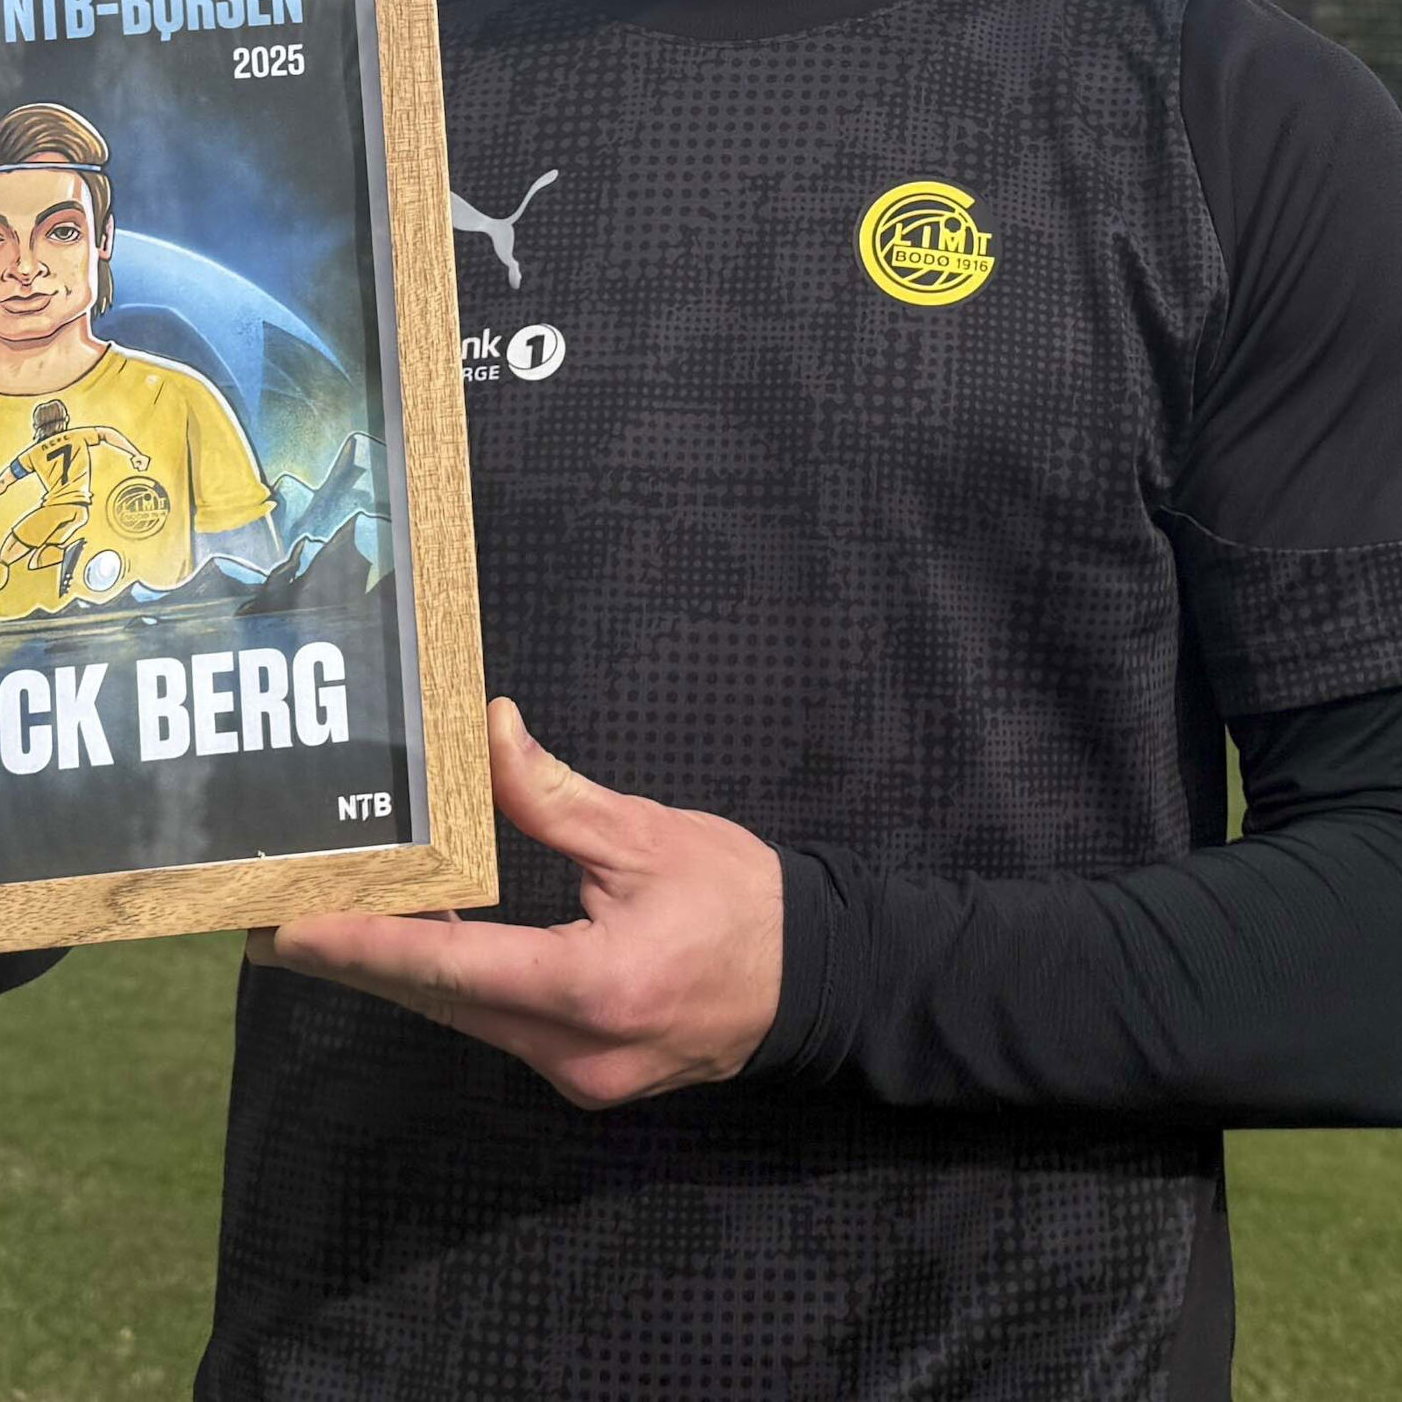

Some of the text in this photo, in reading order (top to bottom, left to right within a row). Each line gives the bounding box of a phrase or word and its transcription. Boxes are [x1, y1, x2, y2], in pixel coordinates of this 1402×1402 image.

[232, 43, 306, 80] 2025
[956, 257, 989, 273] 1916
[461, 328, 502, 360] nk
[463, 365, 500, 382] RGE
[46, 443, 72, 486] 7
[135, 641, 349, 762] BERG
[338, 792, 392, 821] NTB
